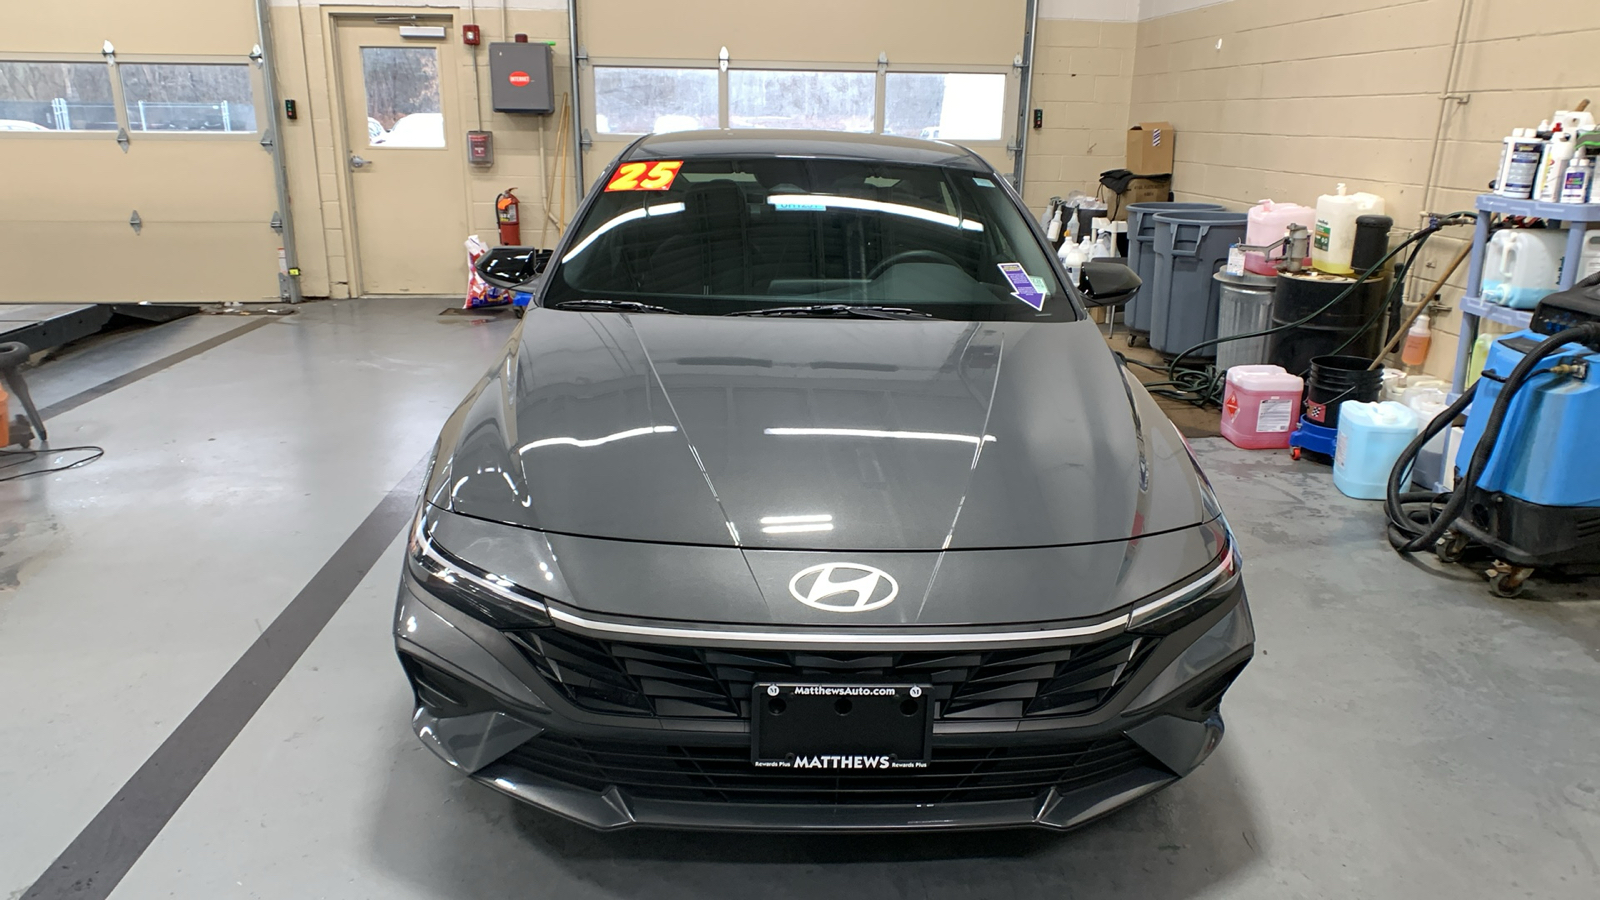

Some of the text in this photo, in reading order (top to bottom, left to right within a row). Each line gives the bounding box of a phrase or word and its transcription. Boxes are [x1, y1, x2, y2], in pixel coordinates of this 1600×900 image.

[608, 161, 681, 190] 25
[794, 686, 896, 696] MatthewsAuto.com
[793, 755, 890, 769] MATTHEWS
